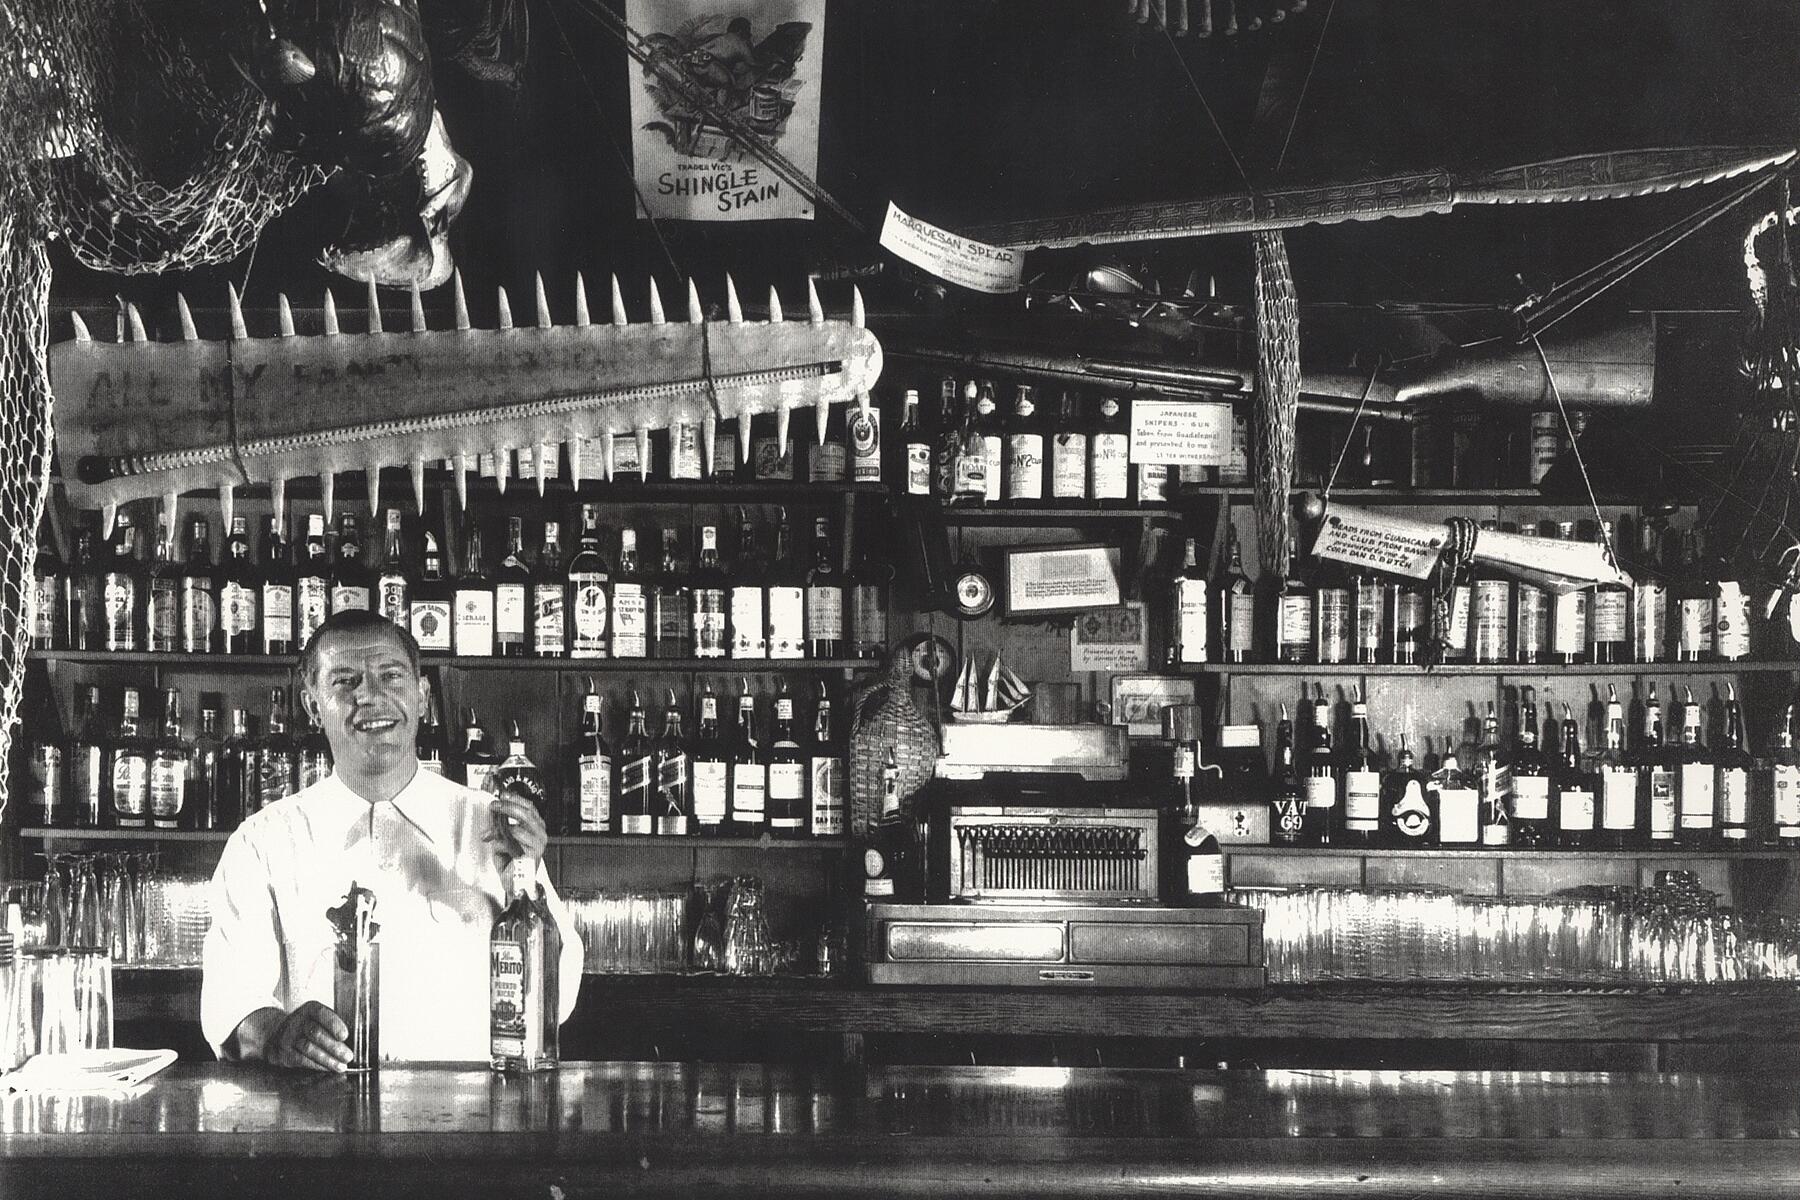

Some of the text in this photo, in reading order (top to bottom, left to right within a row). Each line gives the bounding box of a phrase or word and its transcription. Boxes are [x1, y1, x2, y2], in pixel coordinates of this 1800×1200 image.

[658, 169, 758, 196] SHINGLE
[717, 181, 779, 212] STAIN
[892, 210, 962, 250] MARQUESAN
[968, 243, 1014, 264] SPEAR
[1350, 534, 1376, 546] CLUB
[1378, 541, 1401, 552] FROM
[1359, 529, 1383, 538] FROM
[1349, 549, 1367, 559] DAN
[1272, 798, 1308, 815] VAT
[491, 951, 522, 977] MERITO
